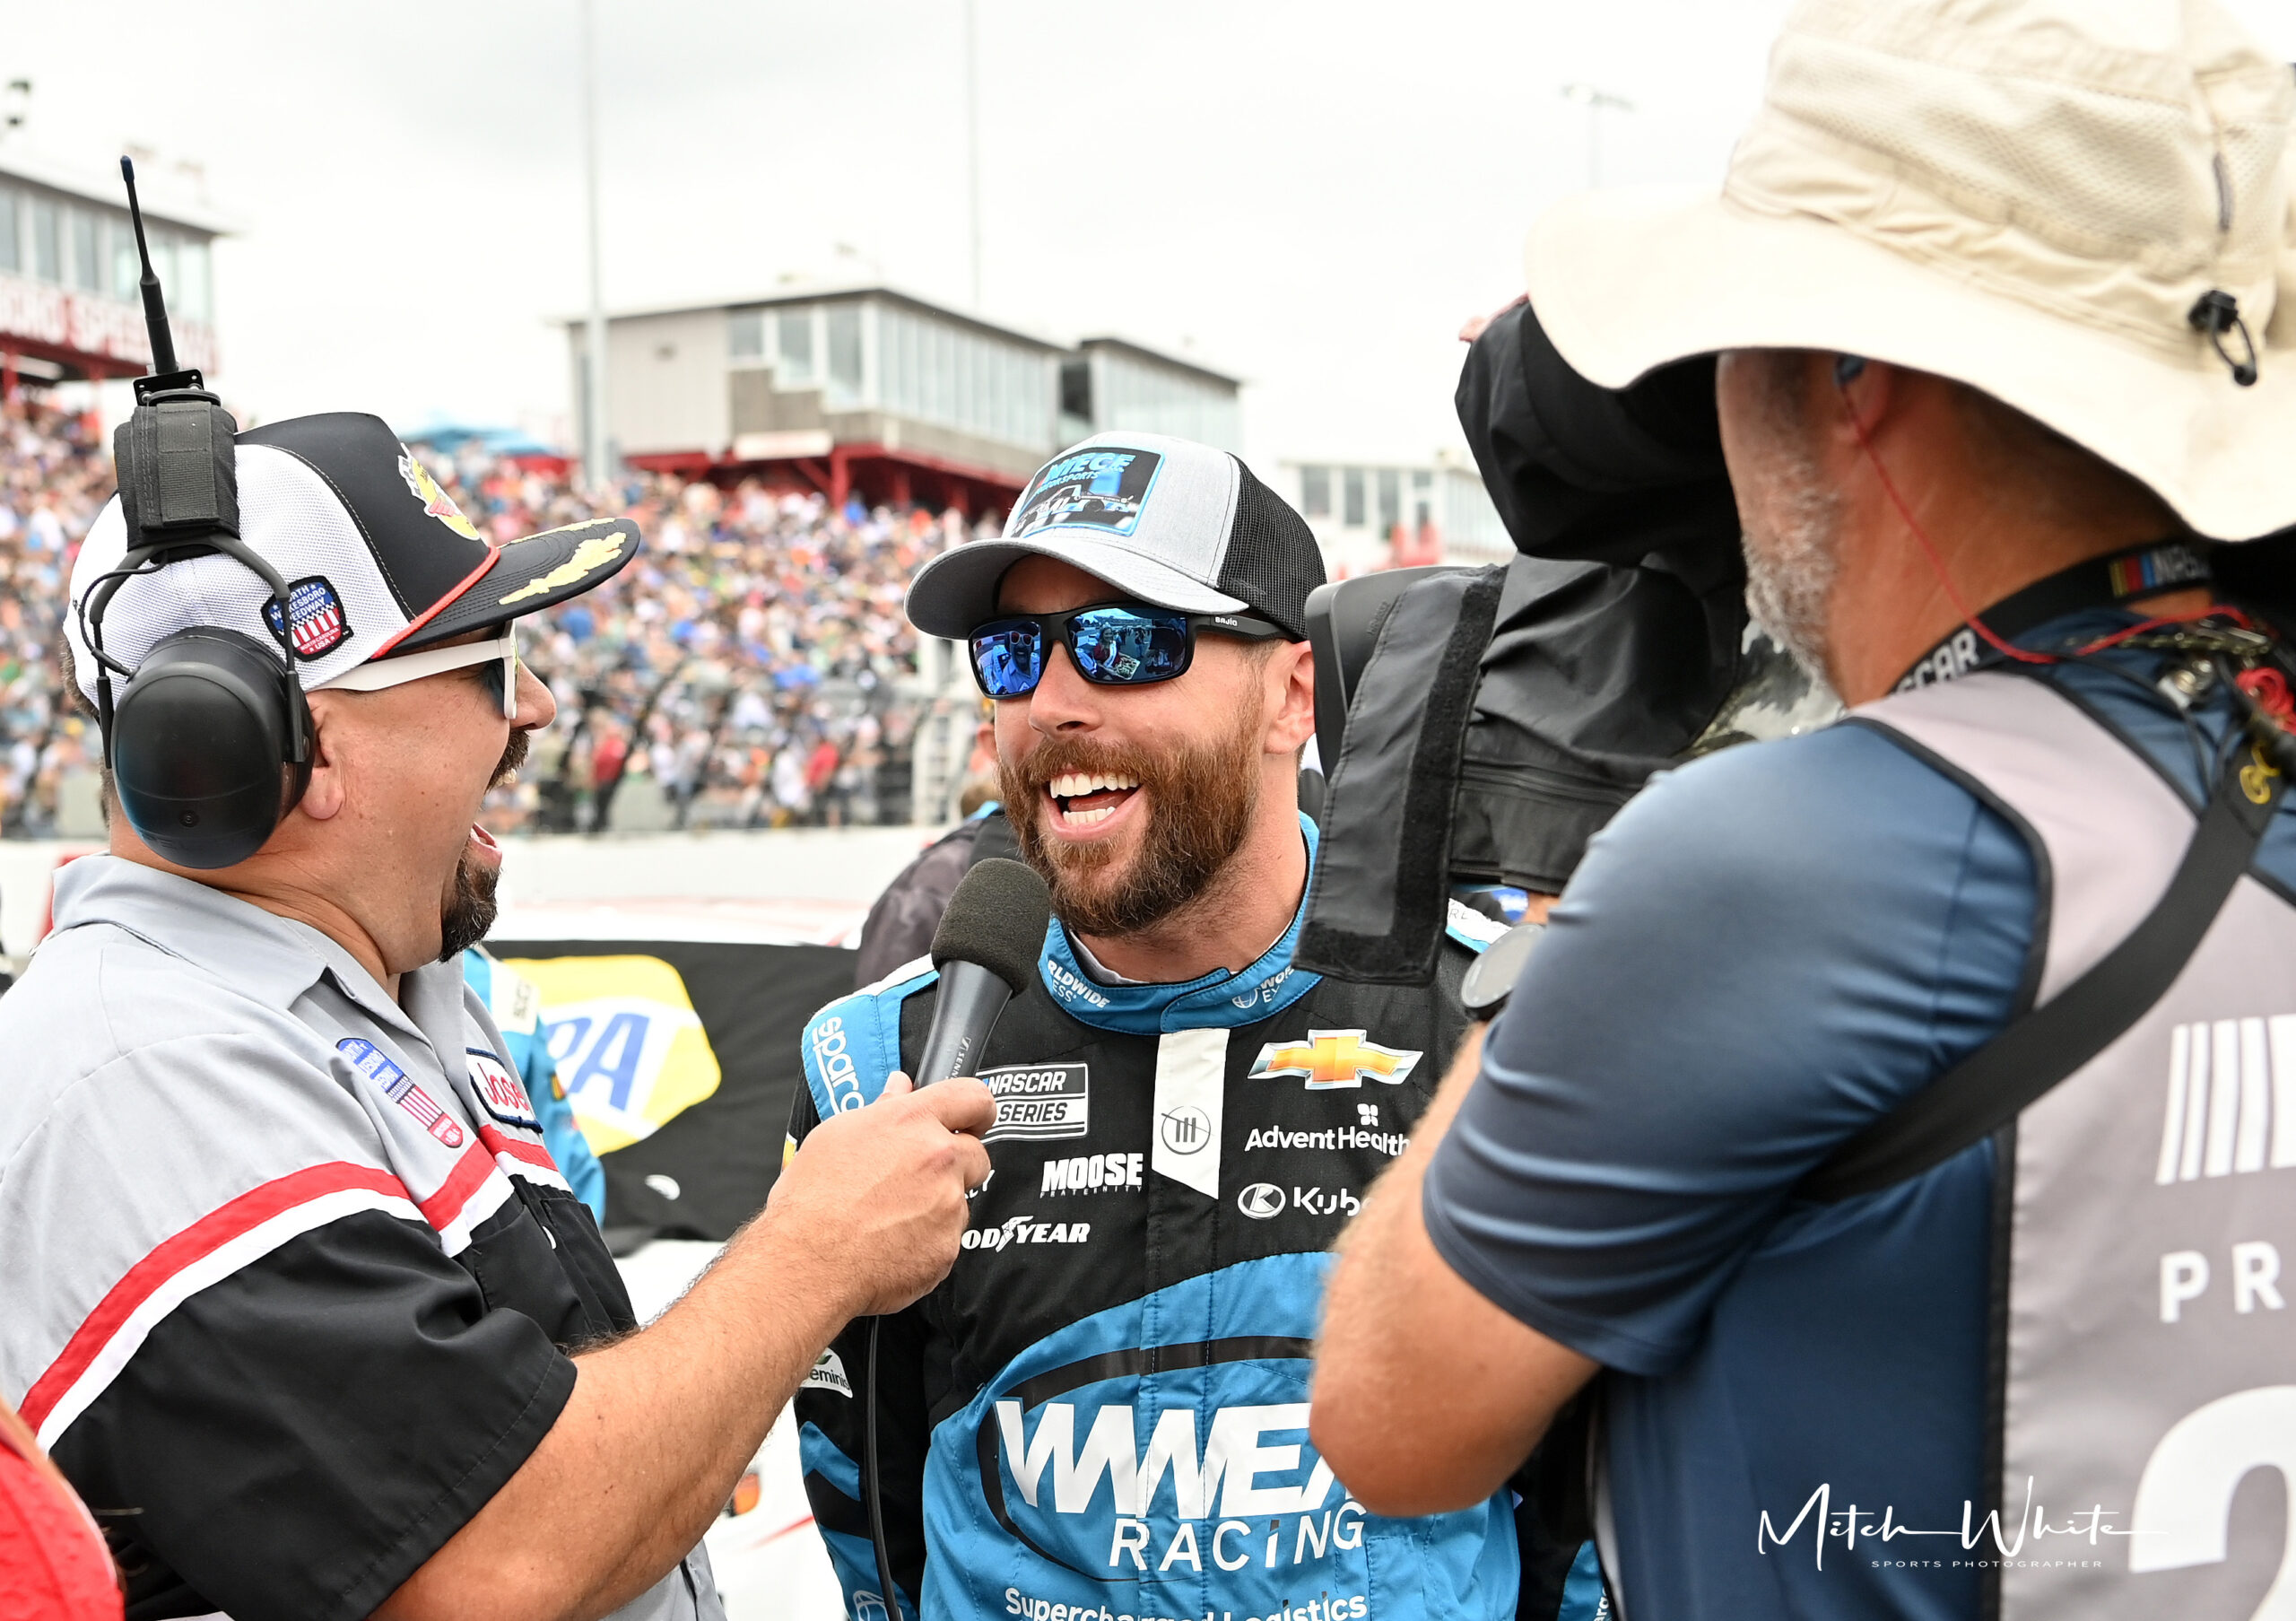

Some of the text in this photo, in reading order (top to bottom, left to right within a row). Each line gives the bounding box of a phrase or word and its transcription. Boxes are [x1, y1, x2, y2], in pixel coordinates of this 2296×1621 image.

[289, 585, 309, 602] RTH
[289, 597, 325, 621] EEDWAY
[315, 639, 331, 649] USA
[1896, 630, 1979, 691] CAR
[1048, 960, 1110, 1008] RLDWIDE
[546, 1013, 650, 1111] PA
[813, 1016, 865, 1112] sparc
[987, 1070, 1067, 1095] NASCAR
[998, 1102, 1067, 1122] SERIES
[1041, 1153, 1144, 1192] MOOSE
[1293, 1186, 1361, 1216] Kub
[961, 1217, 1091, 1251] ODYEAR
[810, 1368, 850, 1390] eminis
